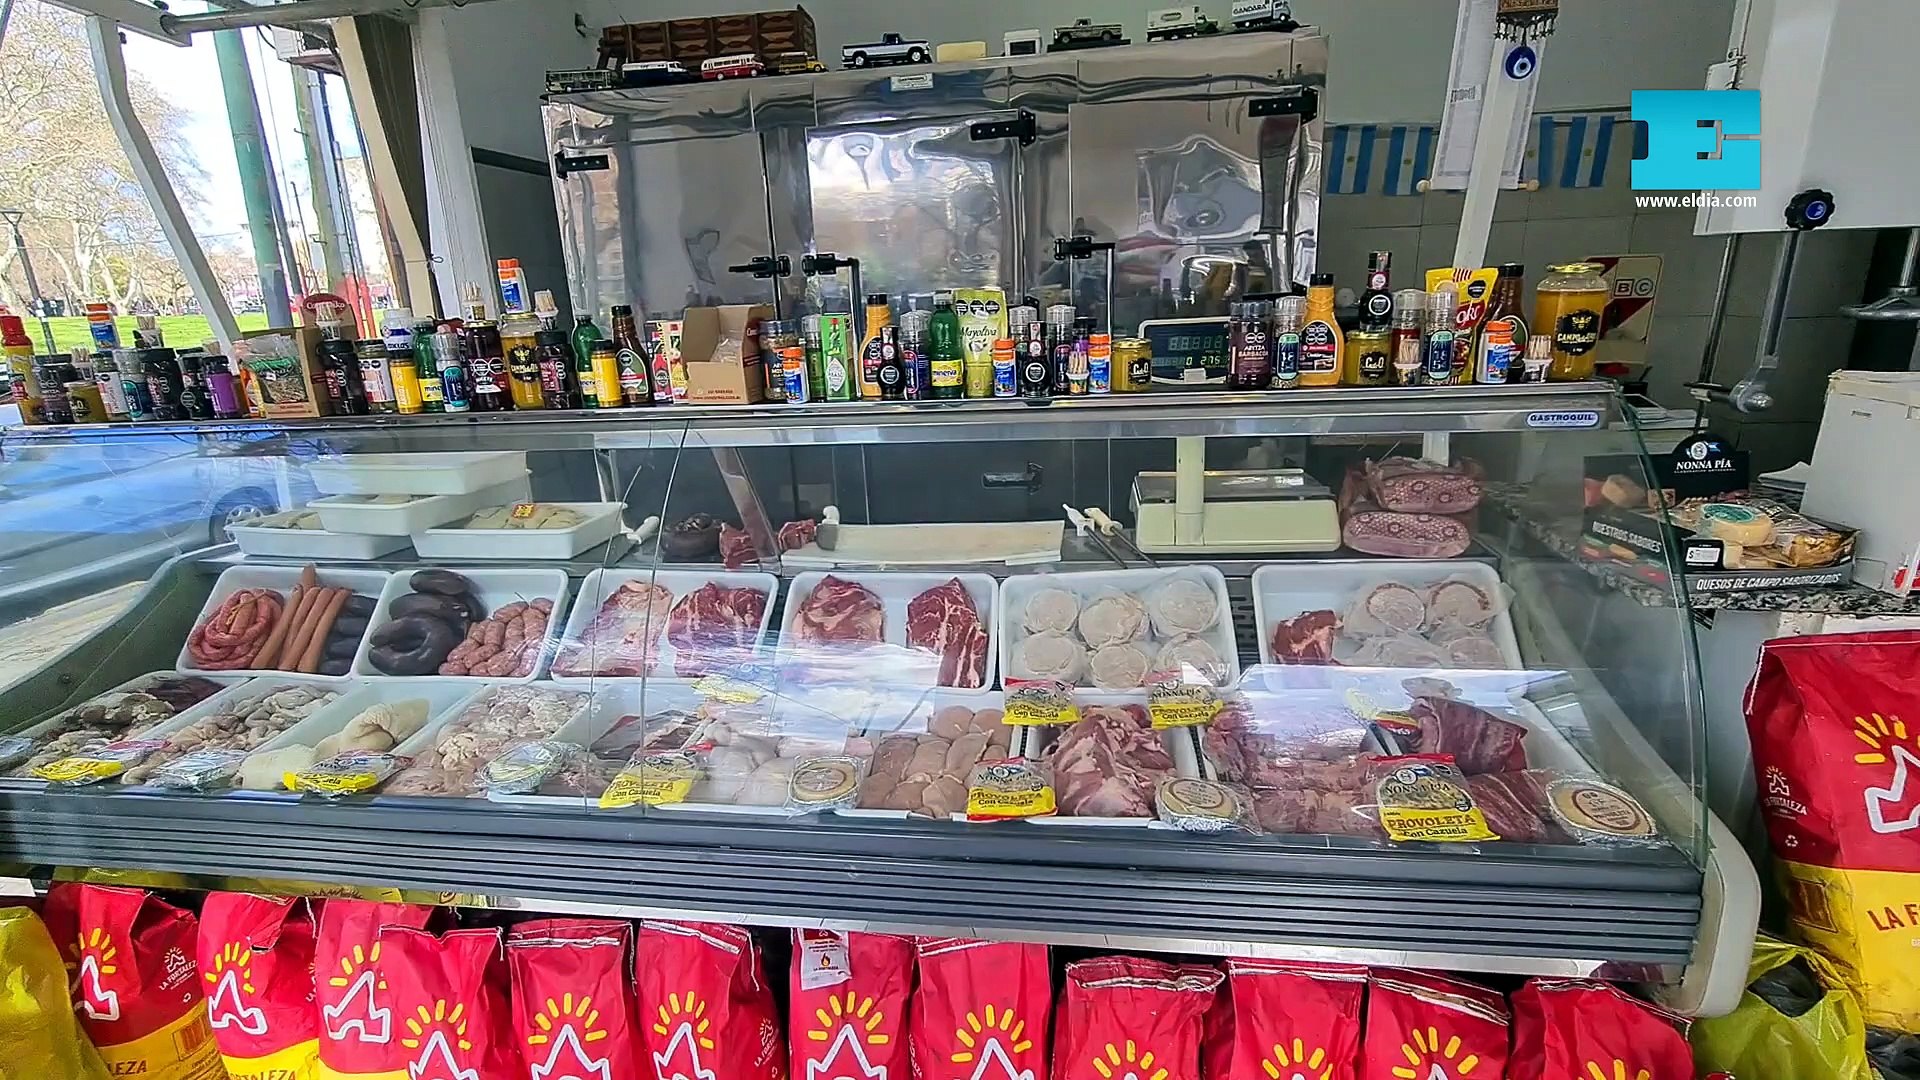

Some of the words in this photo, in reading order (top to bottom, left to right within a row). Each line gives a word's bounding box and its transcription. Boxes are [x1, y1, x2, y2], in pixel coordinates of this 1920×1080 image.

[1233, 3, 1268, 15] GANDARA
[961, 326, 997, 337] Mayoliva
[1530, 414, 1594, 422] GASTROQUIL
[1676, 460, 1713, 470] NONNA
[1592, 521, 1629, 542] NUESTROS
[1629, 533, 1662, 553] SABORES
[1688, 550, 1695, 559] $
[1697, 578, 1733, 590] QUESOS
[1733, 577, 1747, 589] DE
[1747, 577, 1781, 589] CAMPO
[1780, 573, 1842, 586] SABORIZADOS
[971, 790, 1043, 802] PROVOLETA
[1387, 814, 1477, 829] PROVOLETA
[1403, 830, 1425, 838] Con
[1426, 827, 1468, 837] Cazuela
[1867, 906, 1905, 931] LA
[1904, 903, 1920, 926] F
[167, 959, 198, 983] FORTALEZ
